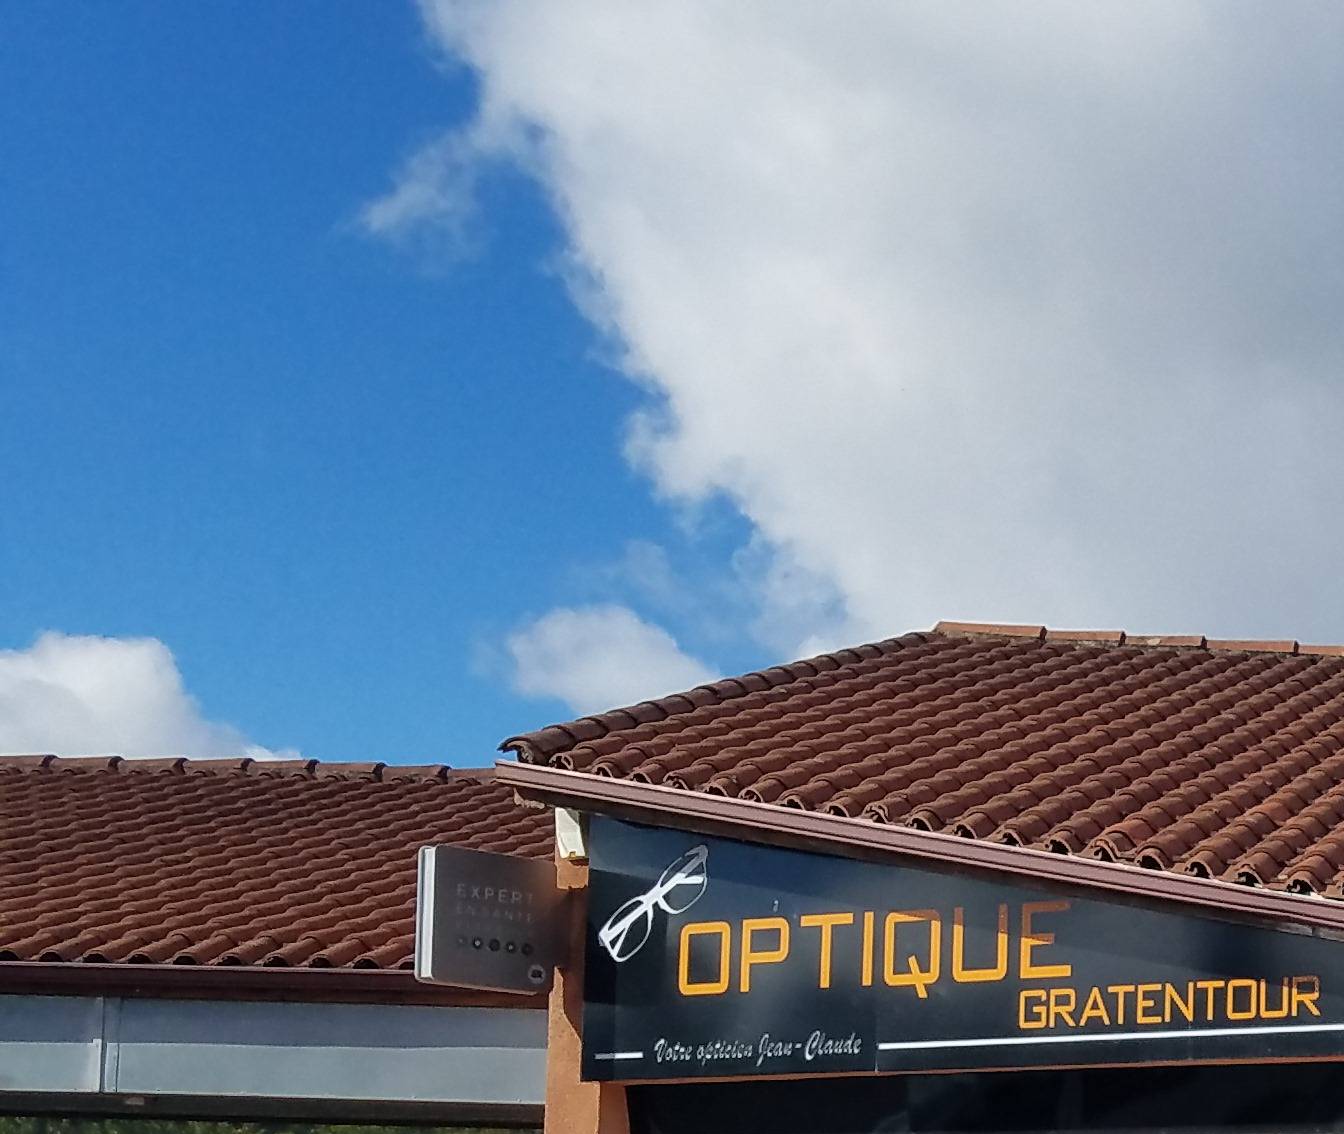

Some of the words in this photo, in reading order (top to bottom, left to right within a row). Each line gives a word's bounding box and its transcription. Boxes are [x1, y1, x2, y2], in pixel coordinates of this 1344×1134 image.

[679, 902, 1073, 999] OPTIQUE
[1018, 976, 1321, 1029] GRATENTOUR
[654, 1038, 692, 1063] Votre
[697, 1040, 753, 1066] opticien
[757, 1030, 862, 1066] Jean-Claude
